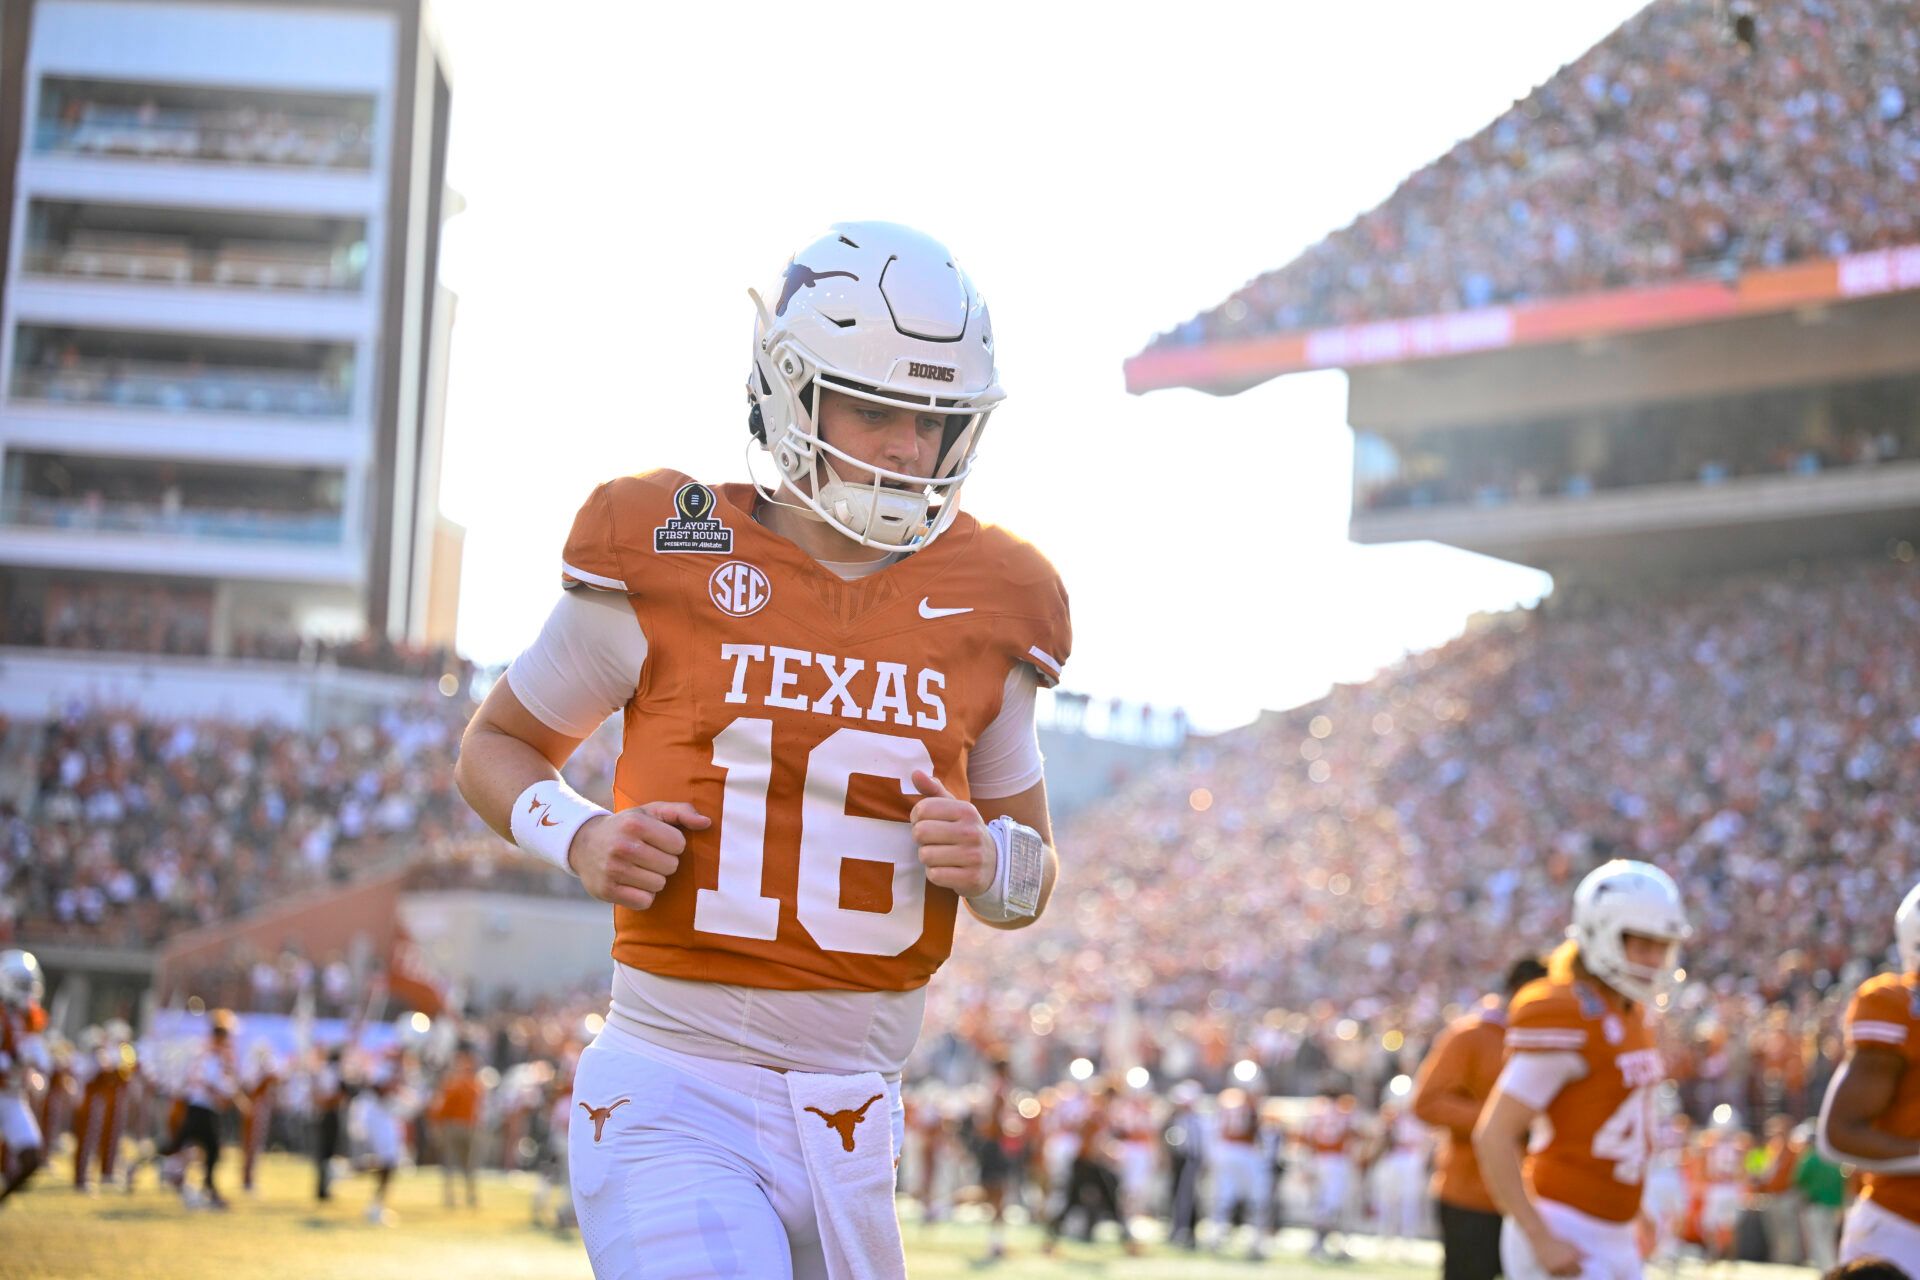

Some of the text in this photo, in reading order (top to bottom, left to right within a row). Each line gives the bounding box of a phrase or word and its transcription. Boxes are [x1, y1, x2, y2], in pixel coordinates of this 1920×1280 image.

[908, 362, 955, 382] HORNS
[658, 531, 729, 541] FIRST ROUND
[671, 521, 718, 531] PLAYOFF
[715, 564, 765, 613] SEC
[721, 643, 947, 731] TEXAS
[694, 717, 934, 957] 16
